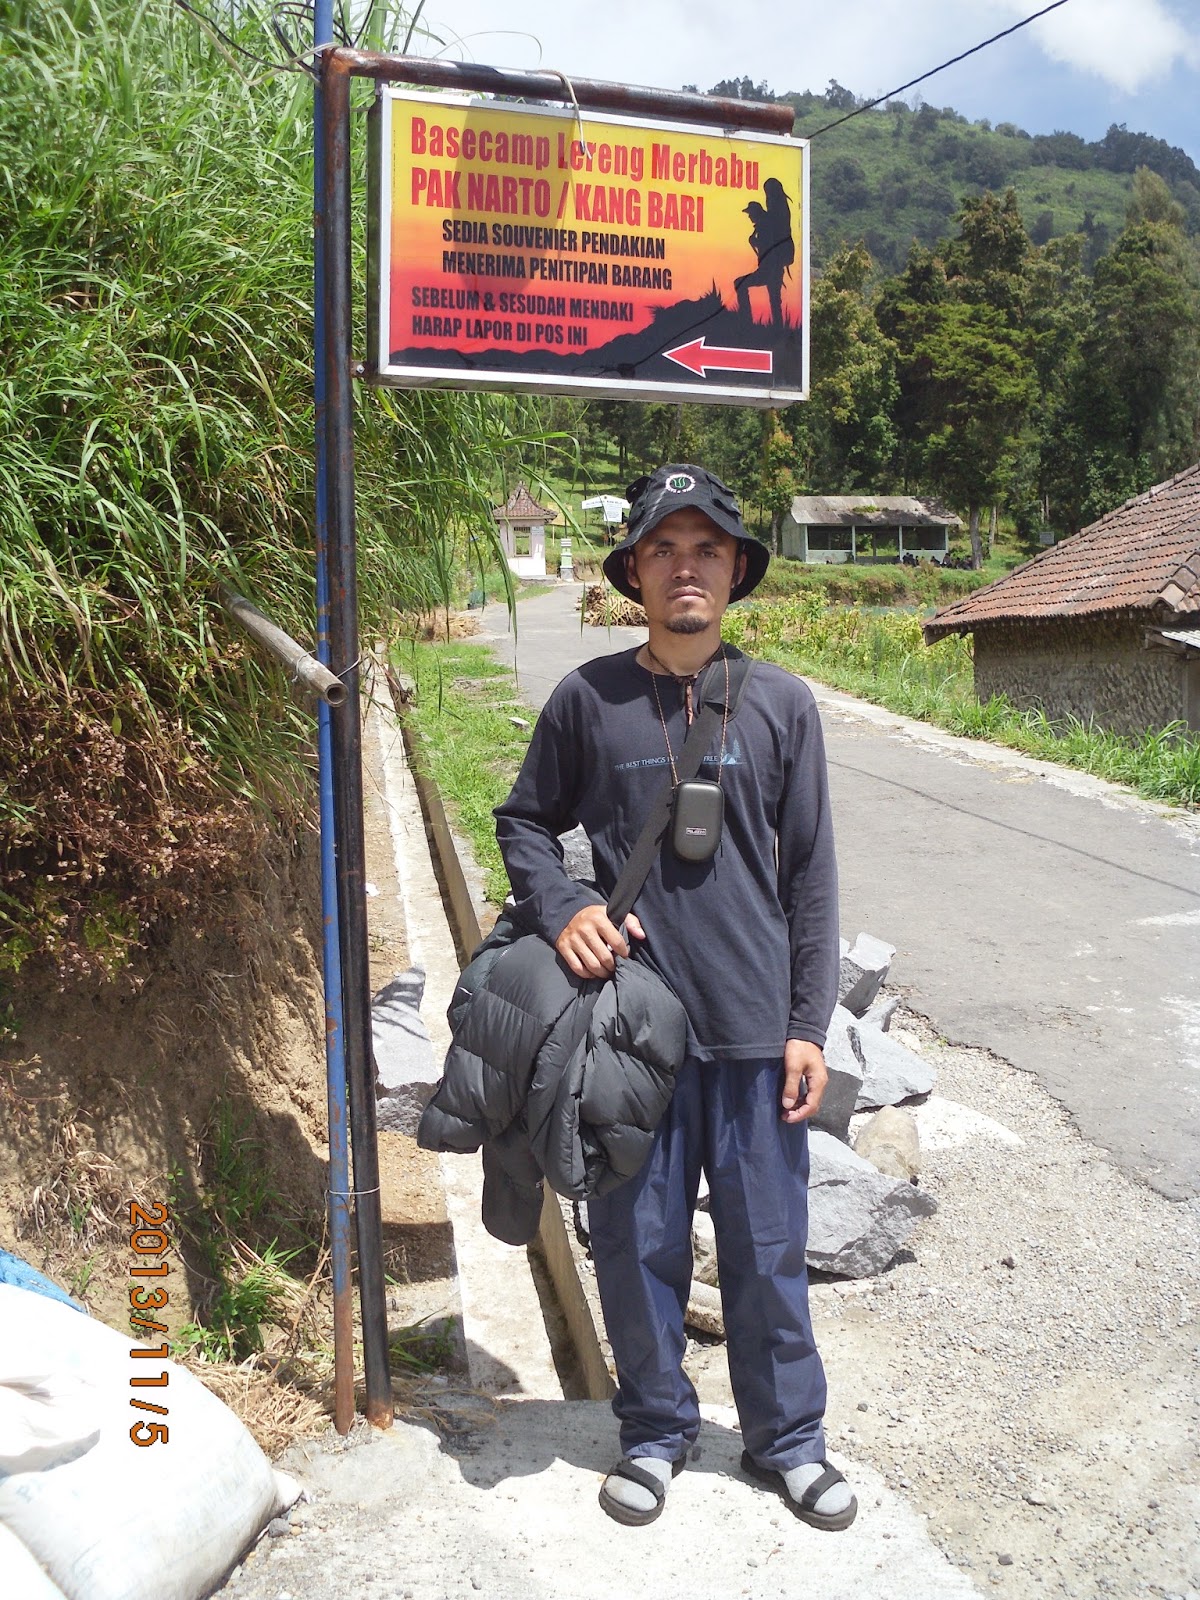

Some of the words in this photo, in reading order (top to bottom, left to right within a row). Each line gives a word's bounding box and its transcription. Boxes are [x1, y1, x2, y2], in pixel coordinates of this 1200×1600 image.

[411, 117, 550, 171] Basecamp
[557, 132, 645, 182] Lereng
[651, 143, 760, 191] Merbabu
[411, 167, 462, 210] PAK
[467, 174, 552, 218] NARTO
[556, 181, 570, 219] /
[575, 183, 641, 227] KANG
[647, 191, 704, 233] BARI
[442, 220, 488, 246] SEDIA
[492, 225, 578, 253] SOUVENIER
[581, 234, 665, 260] PENDAKIAN
[442, 250, 526, 279] MENERIMA
[530, 258, 608, 285] PENITIPAN
[612, 265, 672, 291] BARANG
[411, 286, 480, 311] SEBELUM
[483, 291, 496, 311] &
[499, 292, 566, 317] SESUDAH
[569, 298, 634, 322] MENDAKI
[412, 316, 462, 339] HARAP
[466, 319, 512, 341] LAPOR
[516, 323, 532, 342] DI
[535, 323, 564, 345] POS
[568, 326, 588, 346] INI
[626, 760, 640, 769] BEST
[642, 756, 666, 766] THINGS
